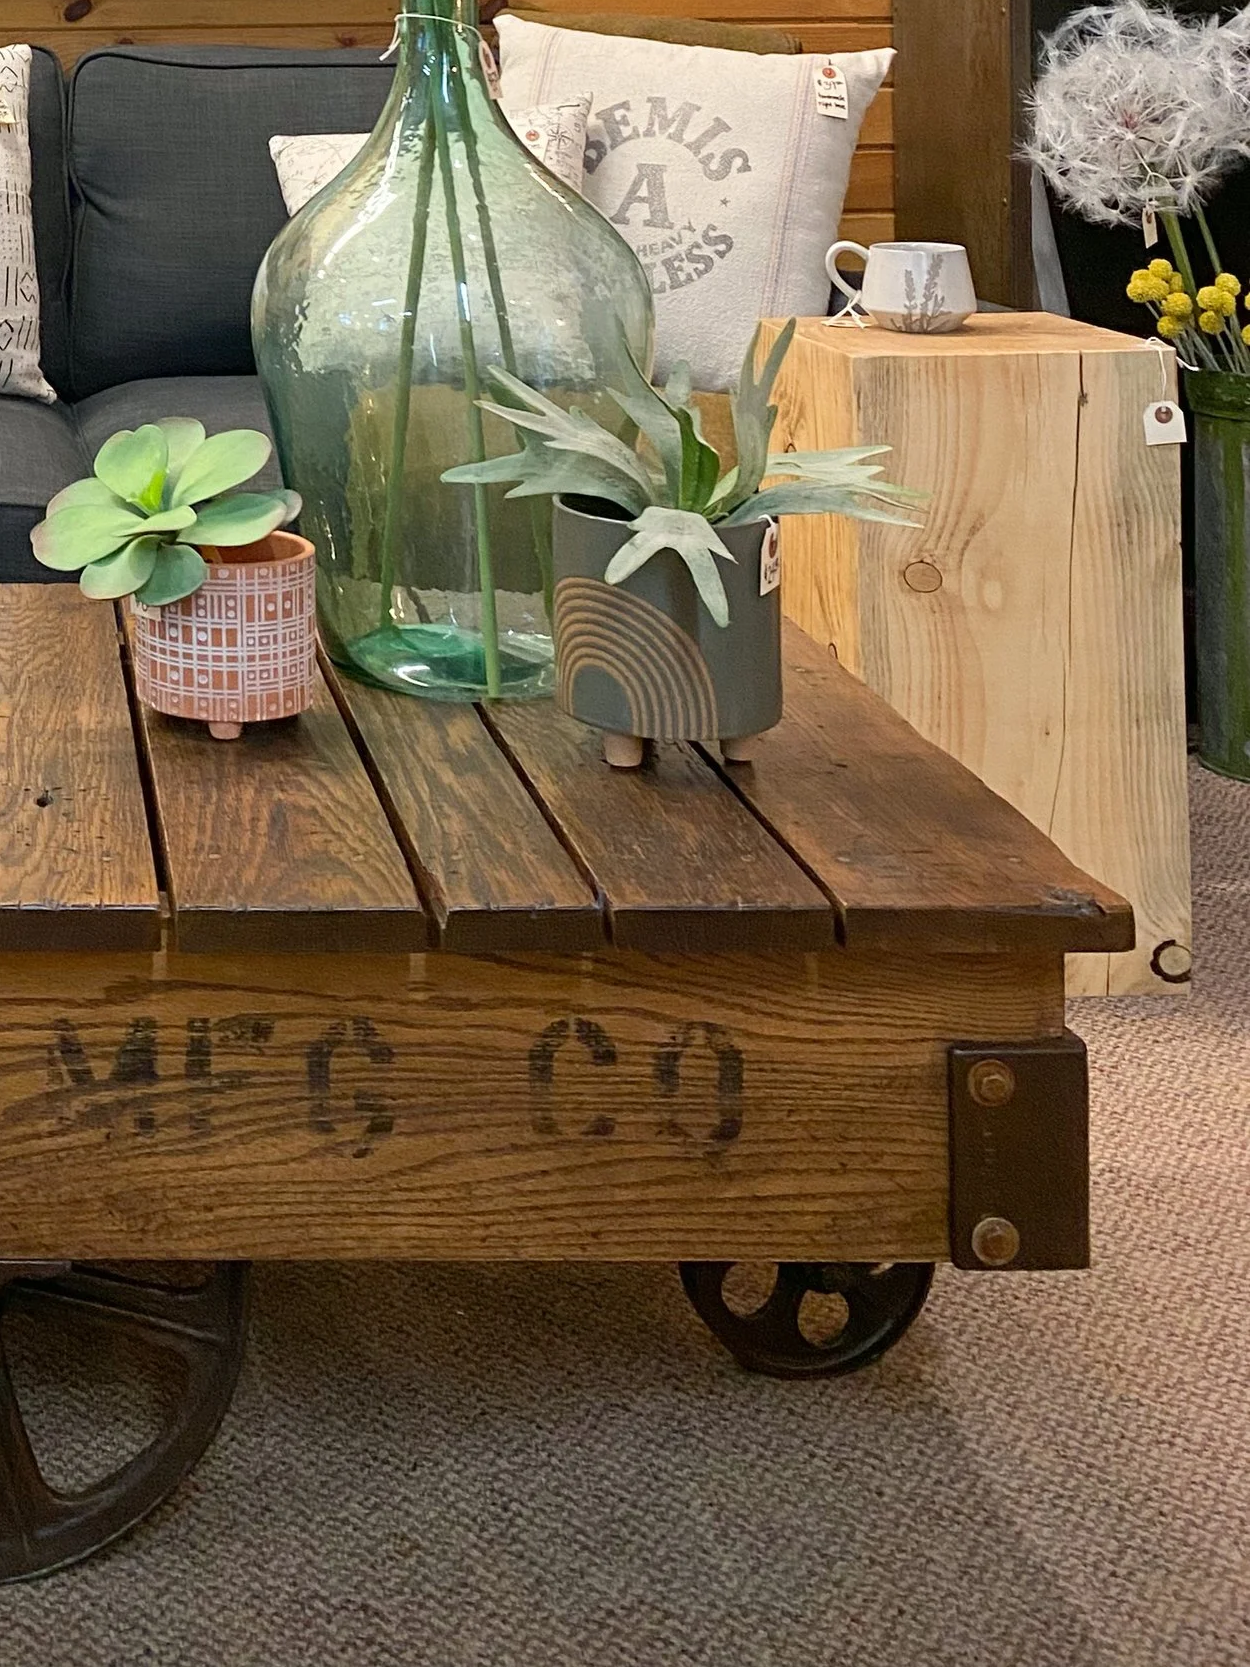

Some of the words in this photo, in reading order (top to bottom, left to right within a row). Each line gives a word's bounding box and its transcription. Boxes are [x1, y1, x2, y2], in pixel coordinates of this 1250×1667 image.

[584, 96, 752, 181] BEMIS
[609, 163, 674, 230] A
[636, 219, 696, 257] HEAVY
[643, 224, 734, 295] LESS
[529, 1017, 743, 1156] CO
